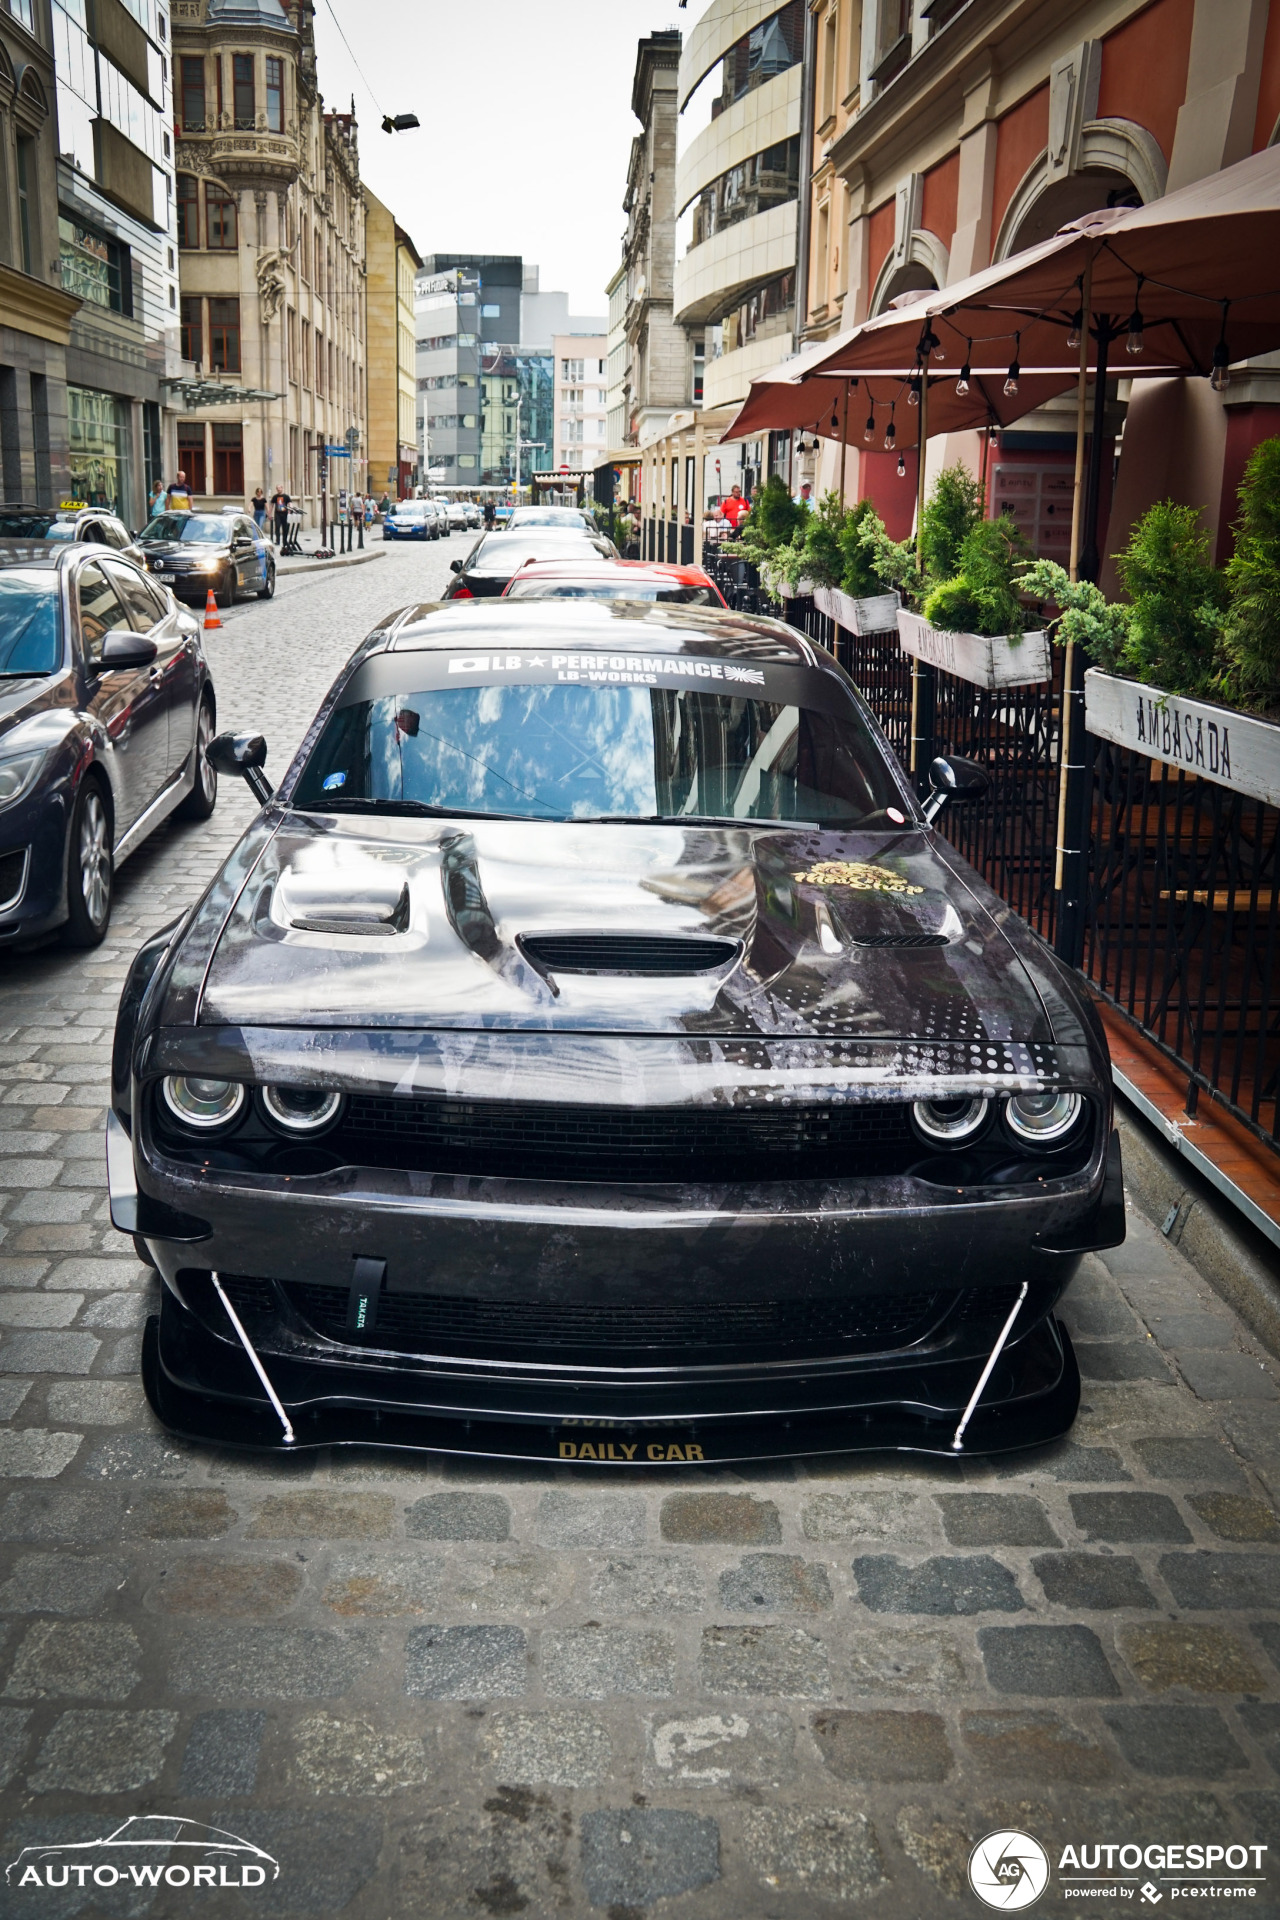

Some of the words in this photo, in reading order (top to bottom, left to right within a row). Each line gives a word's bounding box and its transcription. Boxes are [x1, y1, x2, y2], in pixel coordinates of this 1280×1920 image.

[917, 625, 957, 671] AMBASADA
[493, 655, 521, 671] LB
[552, 655, 724, 679] PERFORMANCE
[558, 670, 658, 684] LB-WORKS
[1136, 695, 1233, 780] AMBASADA
[357, 1297, 368, 1329] TAKATA
[559, 1442, 638, 1460] DAILY
[646, 1443, 704, 1461] CAR
